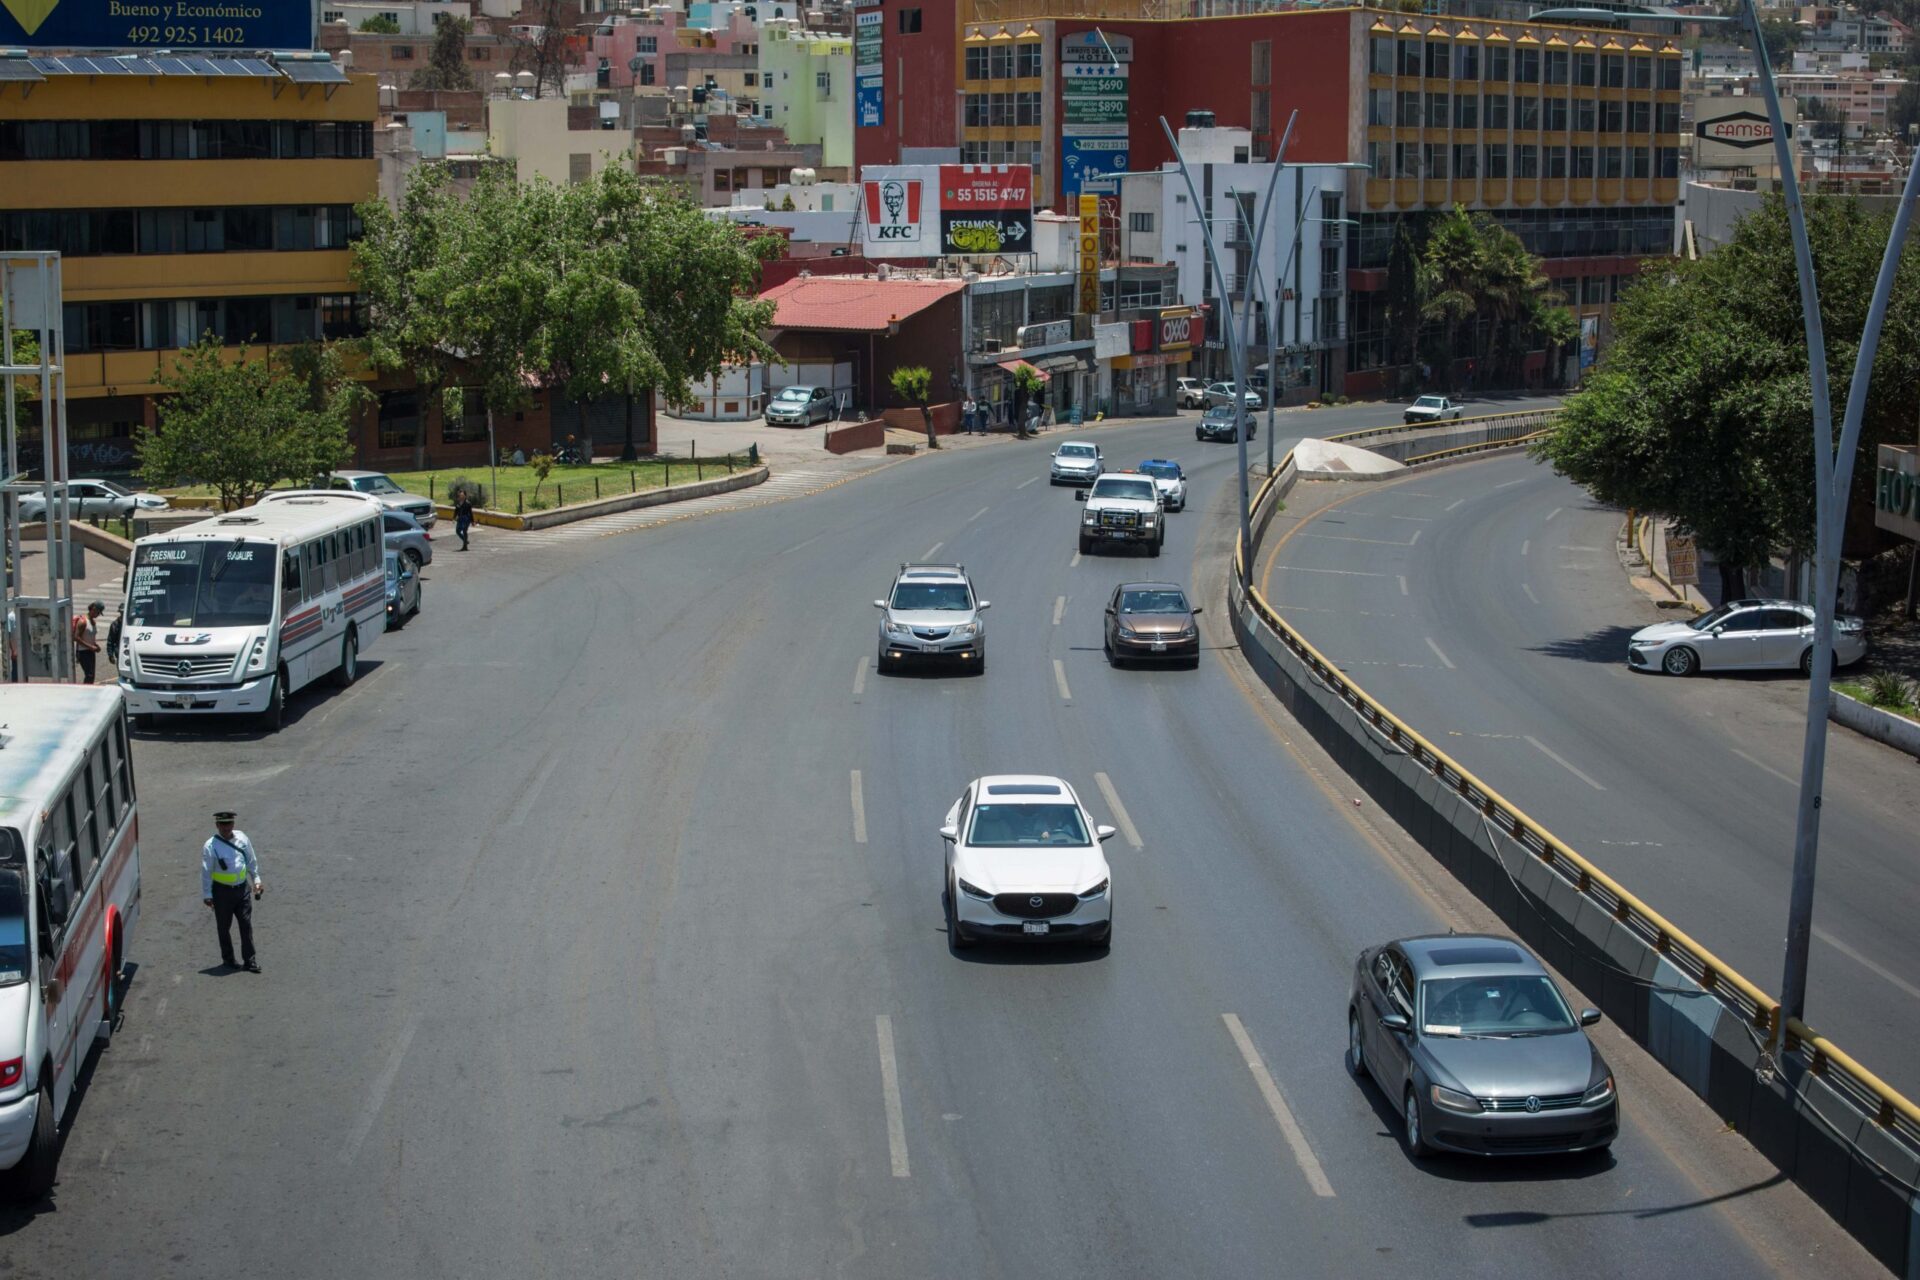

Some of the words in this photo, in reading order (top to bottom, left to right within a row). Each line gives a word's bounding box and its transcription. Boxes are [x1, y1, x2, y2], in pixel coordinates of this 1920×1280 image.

[109, 1, 159, 16] Bueno
[163, 6, 173, 21] y
[176, 2, 262, 18] Económico
[128, 26, 160, 43] 492
[165, 26, 197, 43] 925
[203, 27, 244, 43] 1402
[1098, 79, 1123, 92] $690
[1098, 101, 1123, 112] $890
[1715, 124, 1772, 136] FAMSA
[957, 188, 972, 201] 55
[974, 188, 997, 201] 1515
[1000, 188, 1026, 201] 4747
[878, 226, 911, 239] KFC
[950, 221, 995, 231] ESTAMOS
[997, 221, 1003, 231] A
[1082, 217, 1097, 313] KODAK
[1163, 317, 1190, 344] OXXO
[150, 550, 186, 560] FRESNILLO
[136, 632, 153, 641] 26
